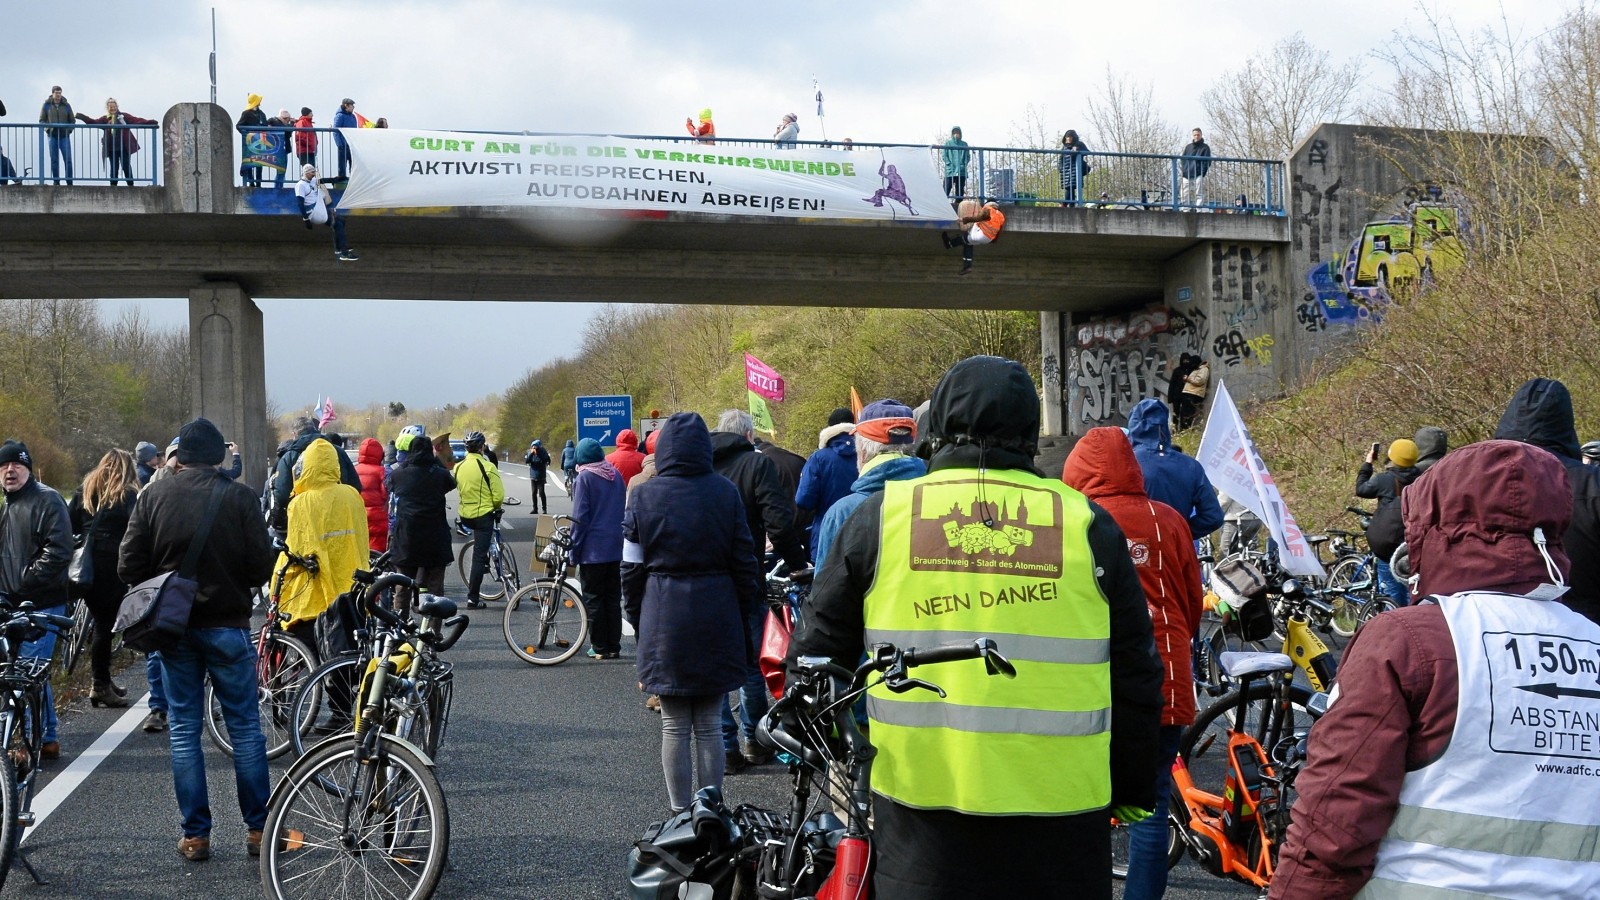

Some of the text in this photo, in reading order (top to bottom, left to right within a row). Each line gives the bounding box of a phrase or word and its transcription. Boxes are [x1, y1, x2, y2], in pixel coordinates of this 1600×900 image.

[409, 136, 856, 177] GURT AN FÜR DIE VERKEHRSWENDE
[408, 159, 712, 186] AKTIVISTI FREISPRECHEN,
[526, 181, 826, 213] AUTOBAHNEN ABREIßEN!
[748, 370, 778, 392] JETZT!
[582, 400, 625, 408] BS-Südstadt
[592, 409, 626, 417] -Heidberg
[913, 556, 969, 568] Braunschweig
[976, 558, 997, 568] Stadt
[998, 559, 1013, 569] des
[1014, 561, 1058, 573] Atommülls
[913, 581, 1058, 619] NEIN DANKE!
[1504, 638, 1598, 678] 1,50m
